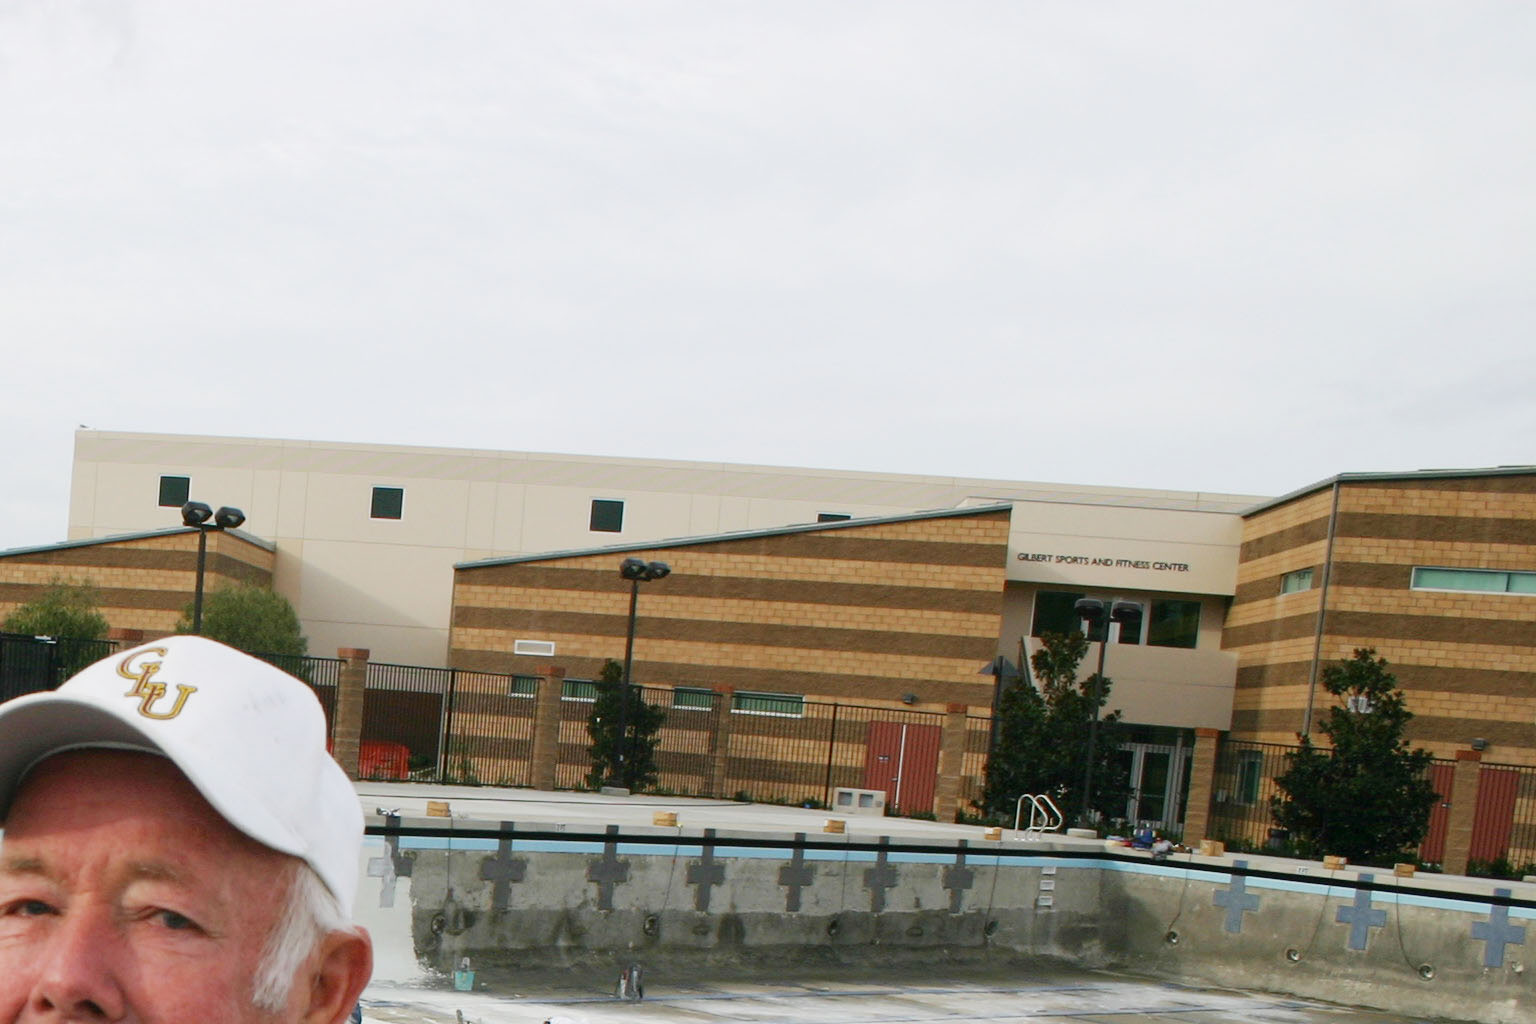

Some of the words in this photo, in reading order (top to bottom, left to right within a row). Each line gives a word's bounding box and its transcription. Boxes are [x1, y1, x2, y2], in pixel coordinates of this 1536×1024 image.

[1017, 552, 1053, 562] GILBERT
[1055, 555, 1089, 566] SPORTS
[1091, 558, 1113, 567] AND
[1116, 559, 1150, 570] FITNESS
[1152, 562, 1189, 572] CENTER
